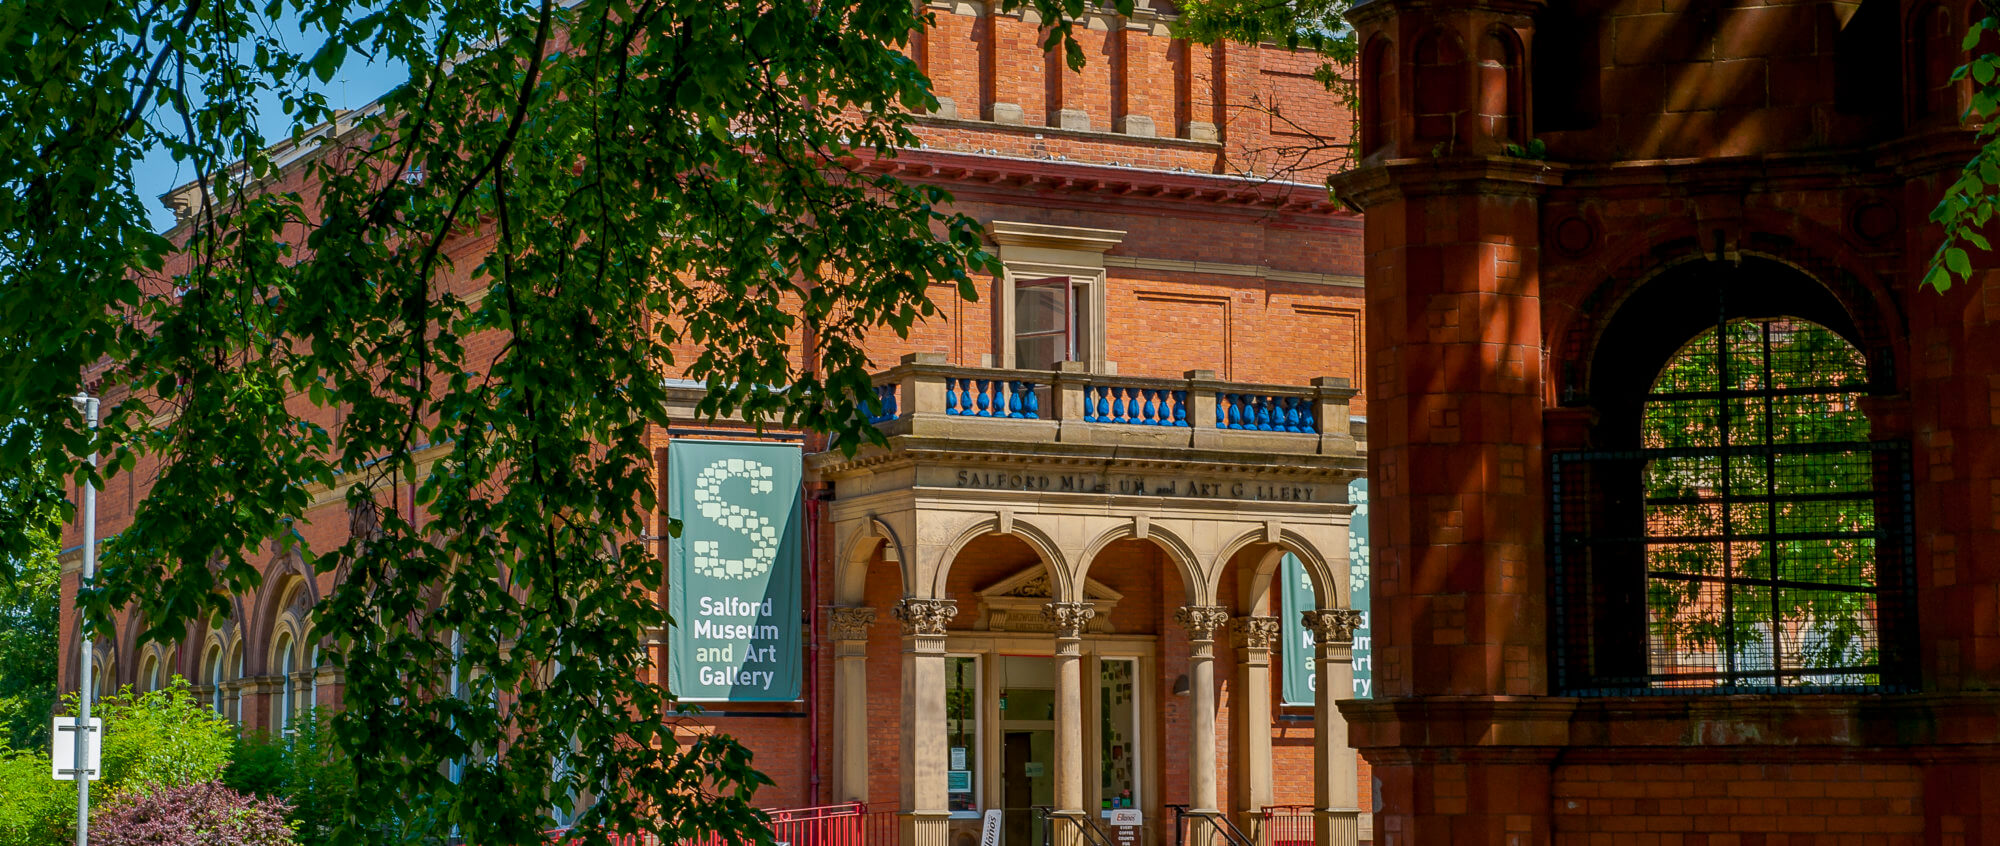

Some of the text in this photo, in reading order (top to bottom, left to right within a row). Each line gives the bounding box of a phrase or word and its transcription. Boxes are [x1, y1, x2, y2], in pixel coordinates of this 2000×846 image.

[957, 470, 1050, 489] SALFORD
[1156, 480, 1176, 495] and
[1188, 480, 1221, 496] ART
[1231, 482, 1314, 500] GLLERY
[699, 596, 773, 617] Salford
[694, 619, 779, 640] Museum
[696, 643, 777, 663] and Art
[699, 666, 774, 691] Gallery
